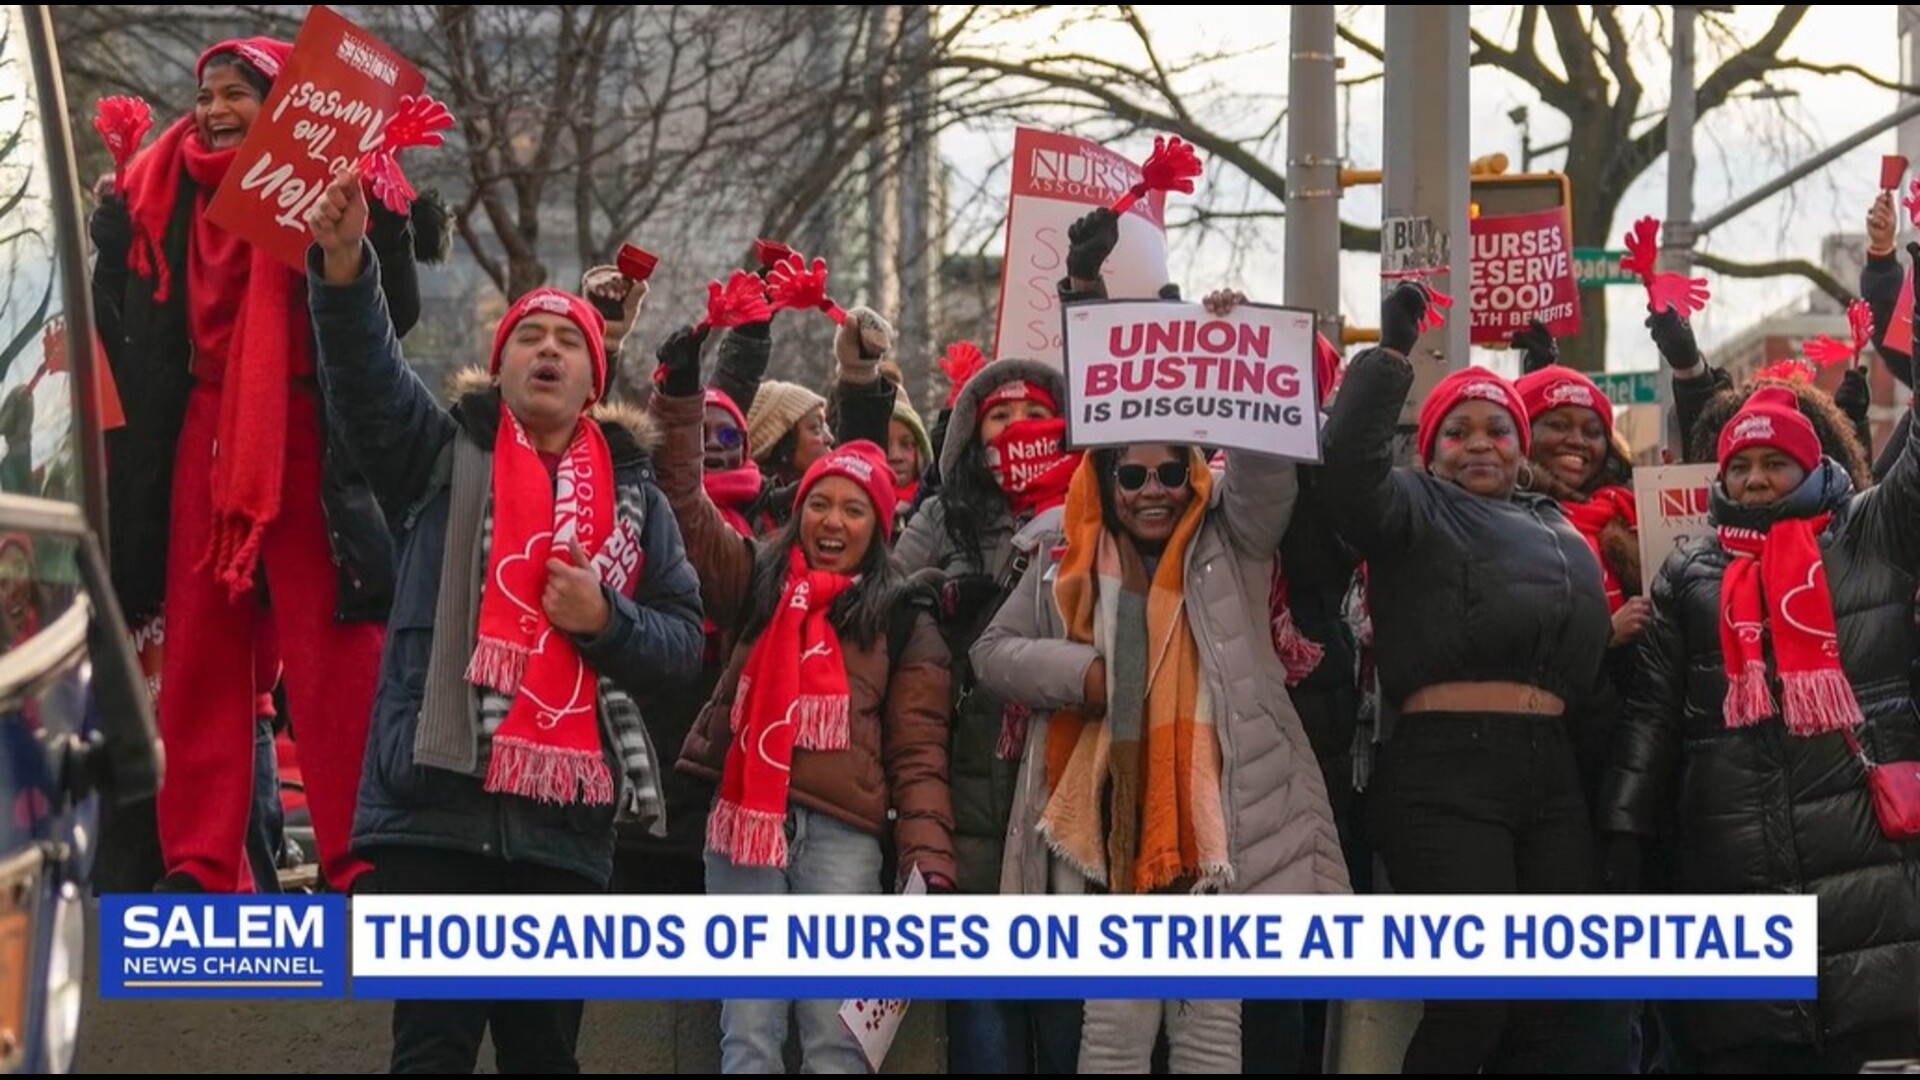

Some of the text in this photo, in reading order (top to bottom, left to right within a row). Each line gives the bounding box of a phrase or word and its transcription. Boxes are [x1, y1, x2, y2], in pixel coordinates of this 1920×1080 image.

[292, 119, 337, 164] The
[1031, 147, 1144, 194] NURS
[240, 152, 327, 233] Ten
[1470, 252, 1568, 287] ESERVE
[1470, 282, 1554, 311] GOOD
[1470, 302, 1574, 328] LTH BENEFITS
[1109, 320, 1271, 359] UNION
[1085, 356, 1301, 399] BUSTING
[1083, 396, 1302, 426] IS DISGUSTING
[1007, 437, 1060, 461] Natio
